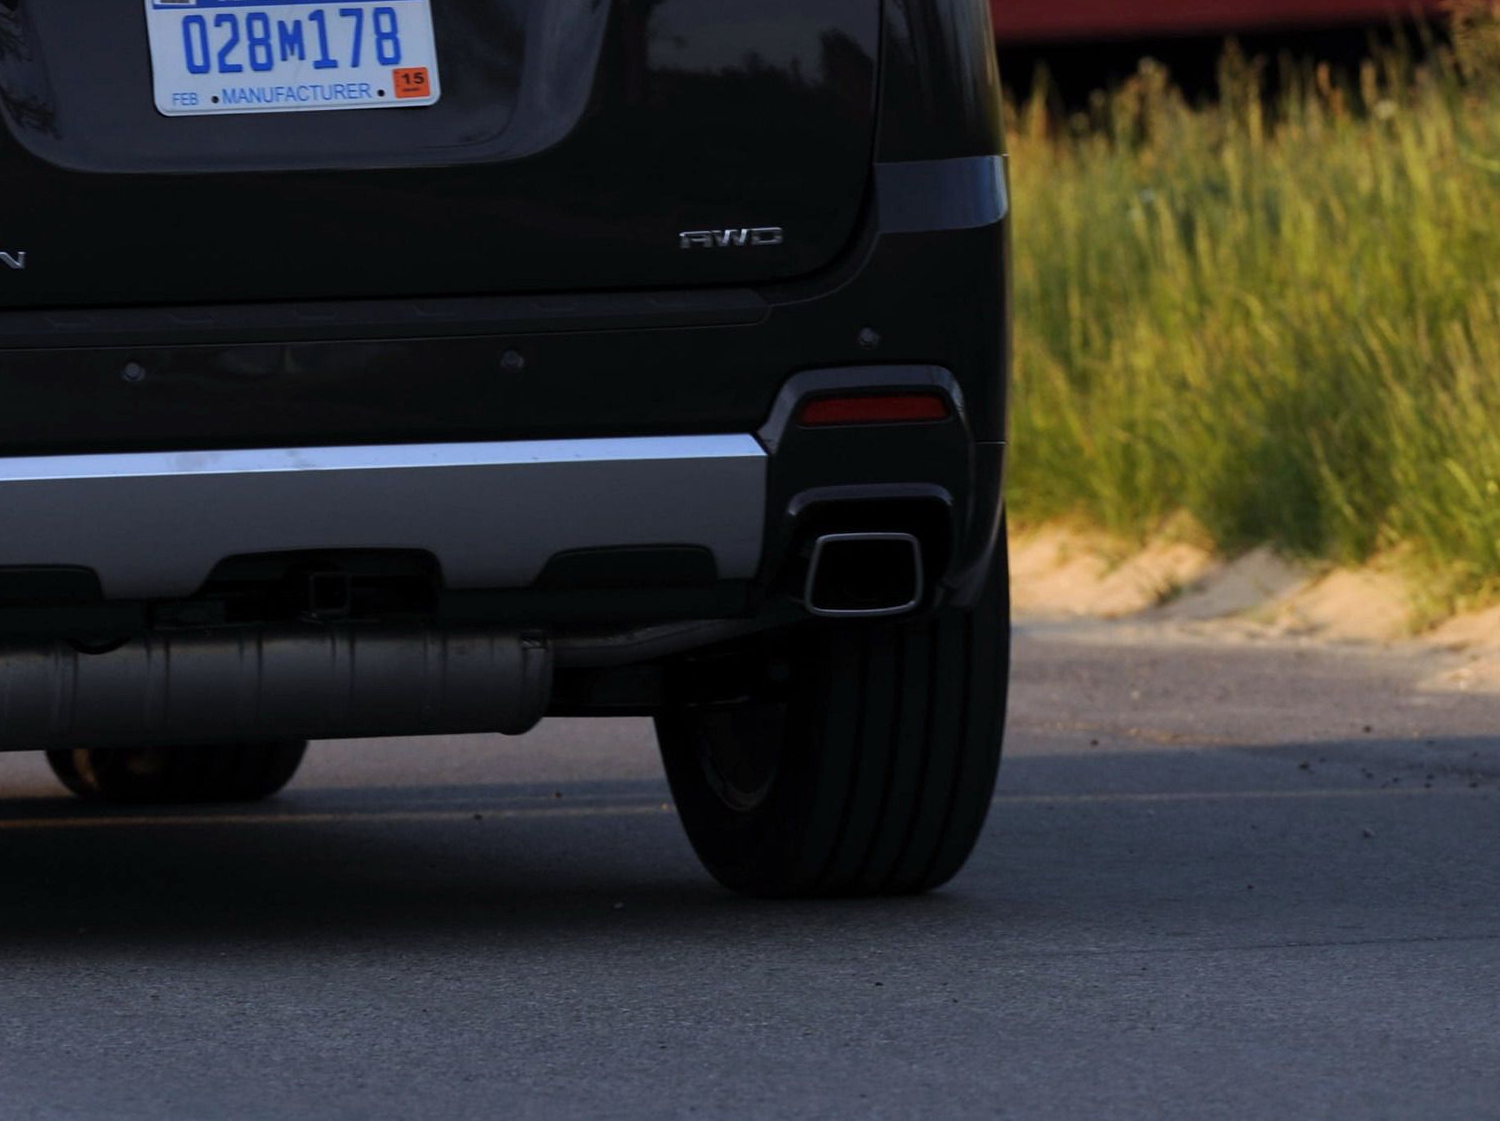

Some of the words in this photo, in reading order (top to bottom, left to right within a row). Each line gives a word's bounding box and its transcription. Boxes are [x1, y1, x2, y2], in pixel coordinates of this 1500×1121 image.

[181, 6, 402, 75] 028M178
[401, 71, 426, 85] 15
[171, 92, 199, 107] FEB
[221, 83, 373, 105] MANUFACTURER
[679, 226, 783, 249] AWD
